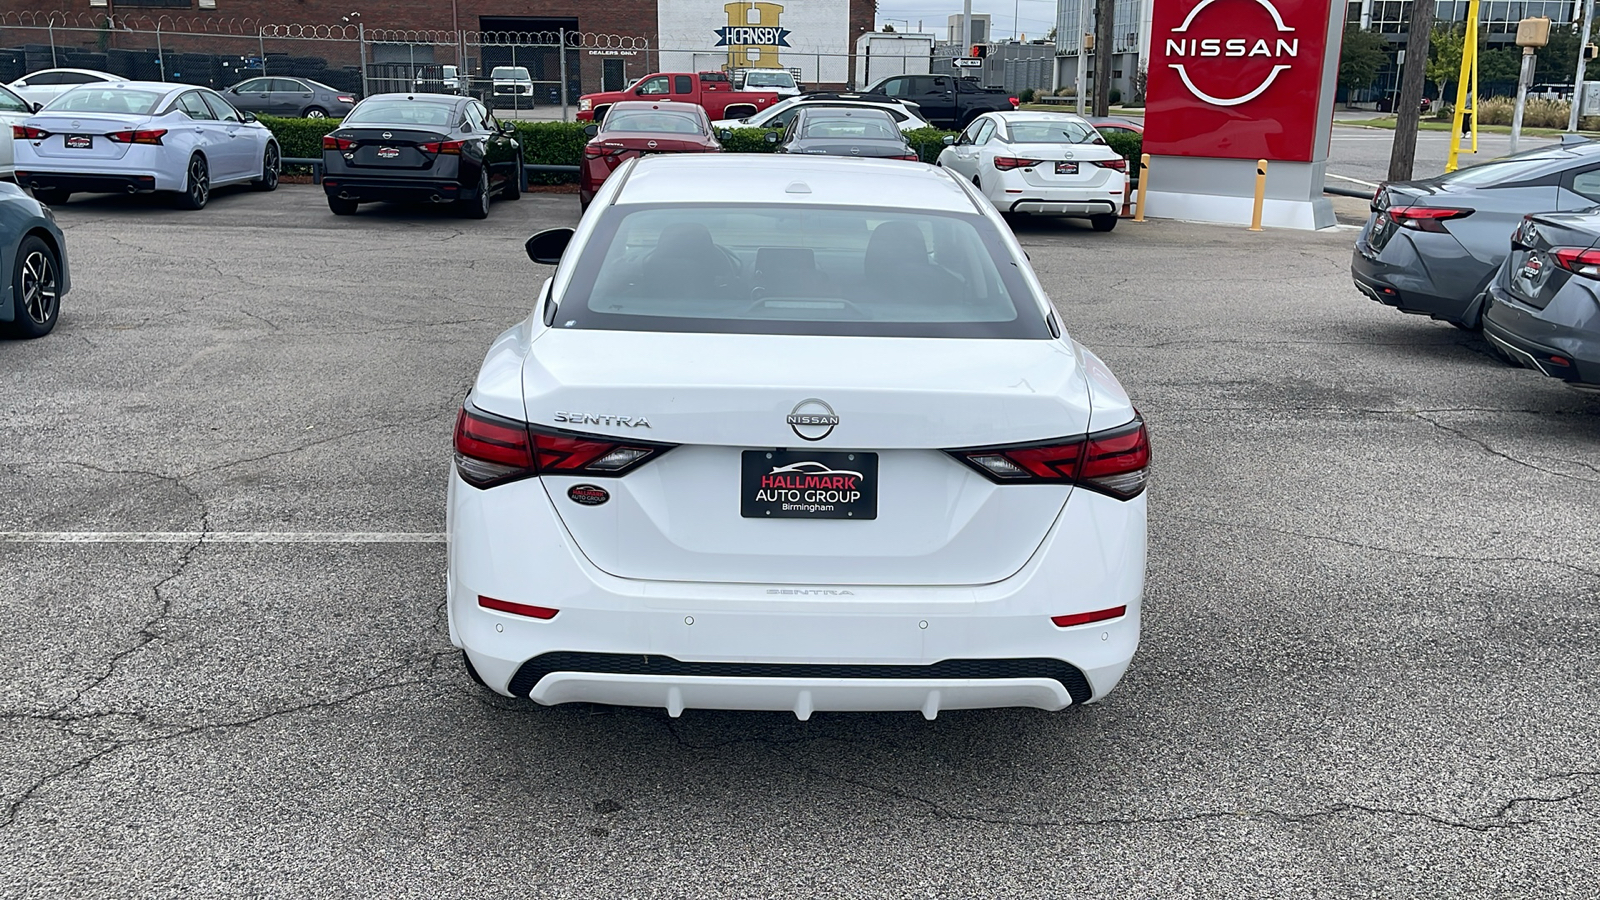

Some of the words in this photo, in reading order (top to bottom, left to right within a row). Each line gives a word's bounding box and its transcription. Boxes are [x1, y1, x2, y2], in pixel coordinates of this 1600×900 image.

[725, 27, 782, 45] HORNSBY
[1165, 38, 1299, 57] NISSAN
[554, 410, 652, 428] SENTRA
[788, 416, 838, 424] NISSAN
[761, 475, 856, 489] HALLMARK
[755, 489, 800, 502] AUTO
[804, 490, 860, 503] GROUP
[782, 503, 834, 512] Birmingham
